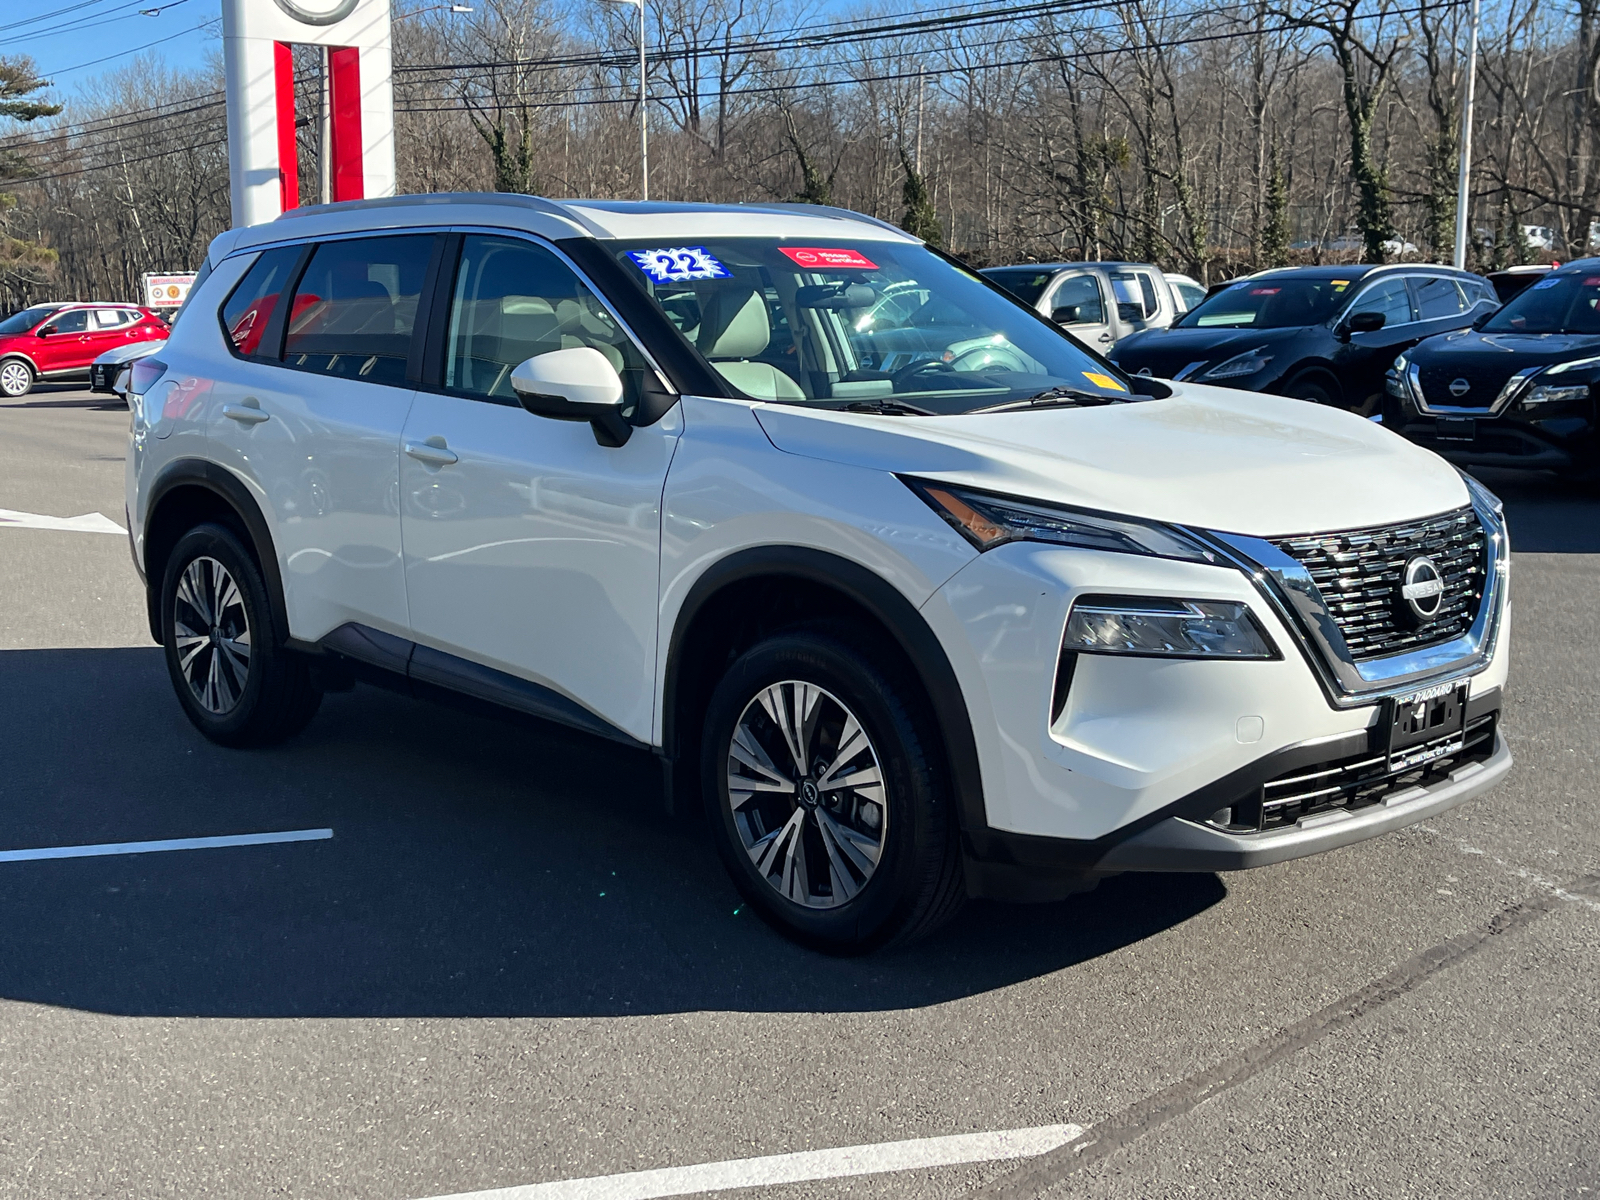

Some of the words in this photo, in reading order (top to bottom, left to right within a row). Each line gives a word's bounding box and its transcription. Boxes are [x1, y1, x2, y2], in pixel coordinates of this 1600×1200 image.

[656, 253, 706, 274] 22
[1405, 580, 1444, 597] NISSAN
[1413, 683, 1453, 704] D'ADDARIO
